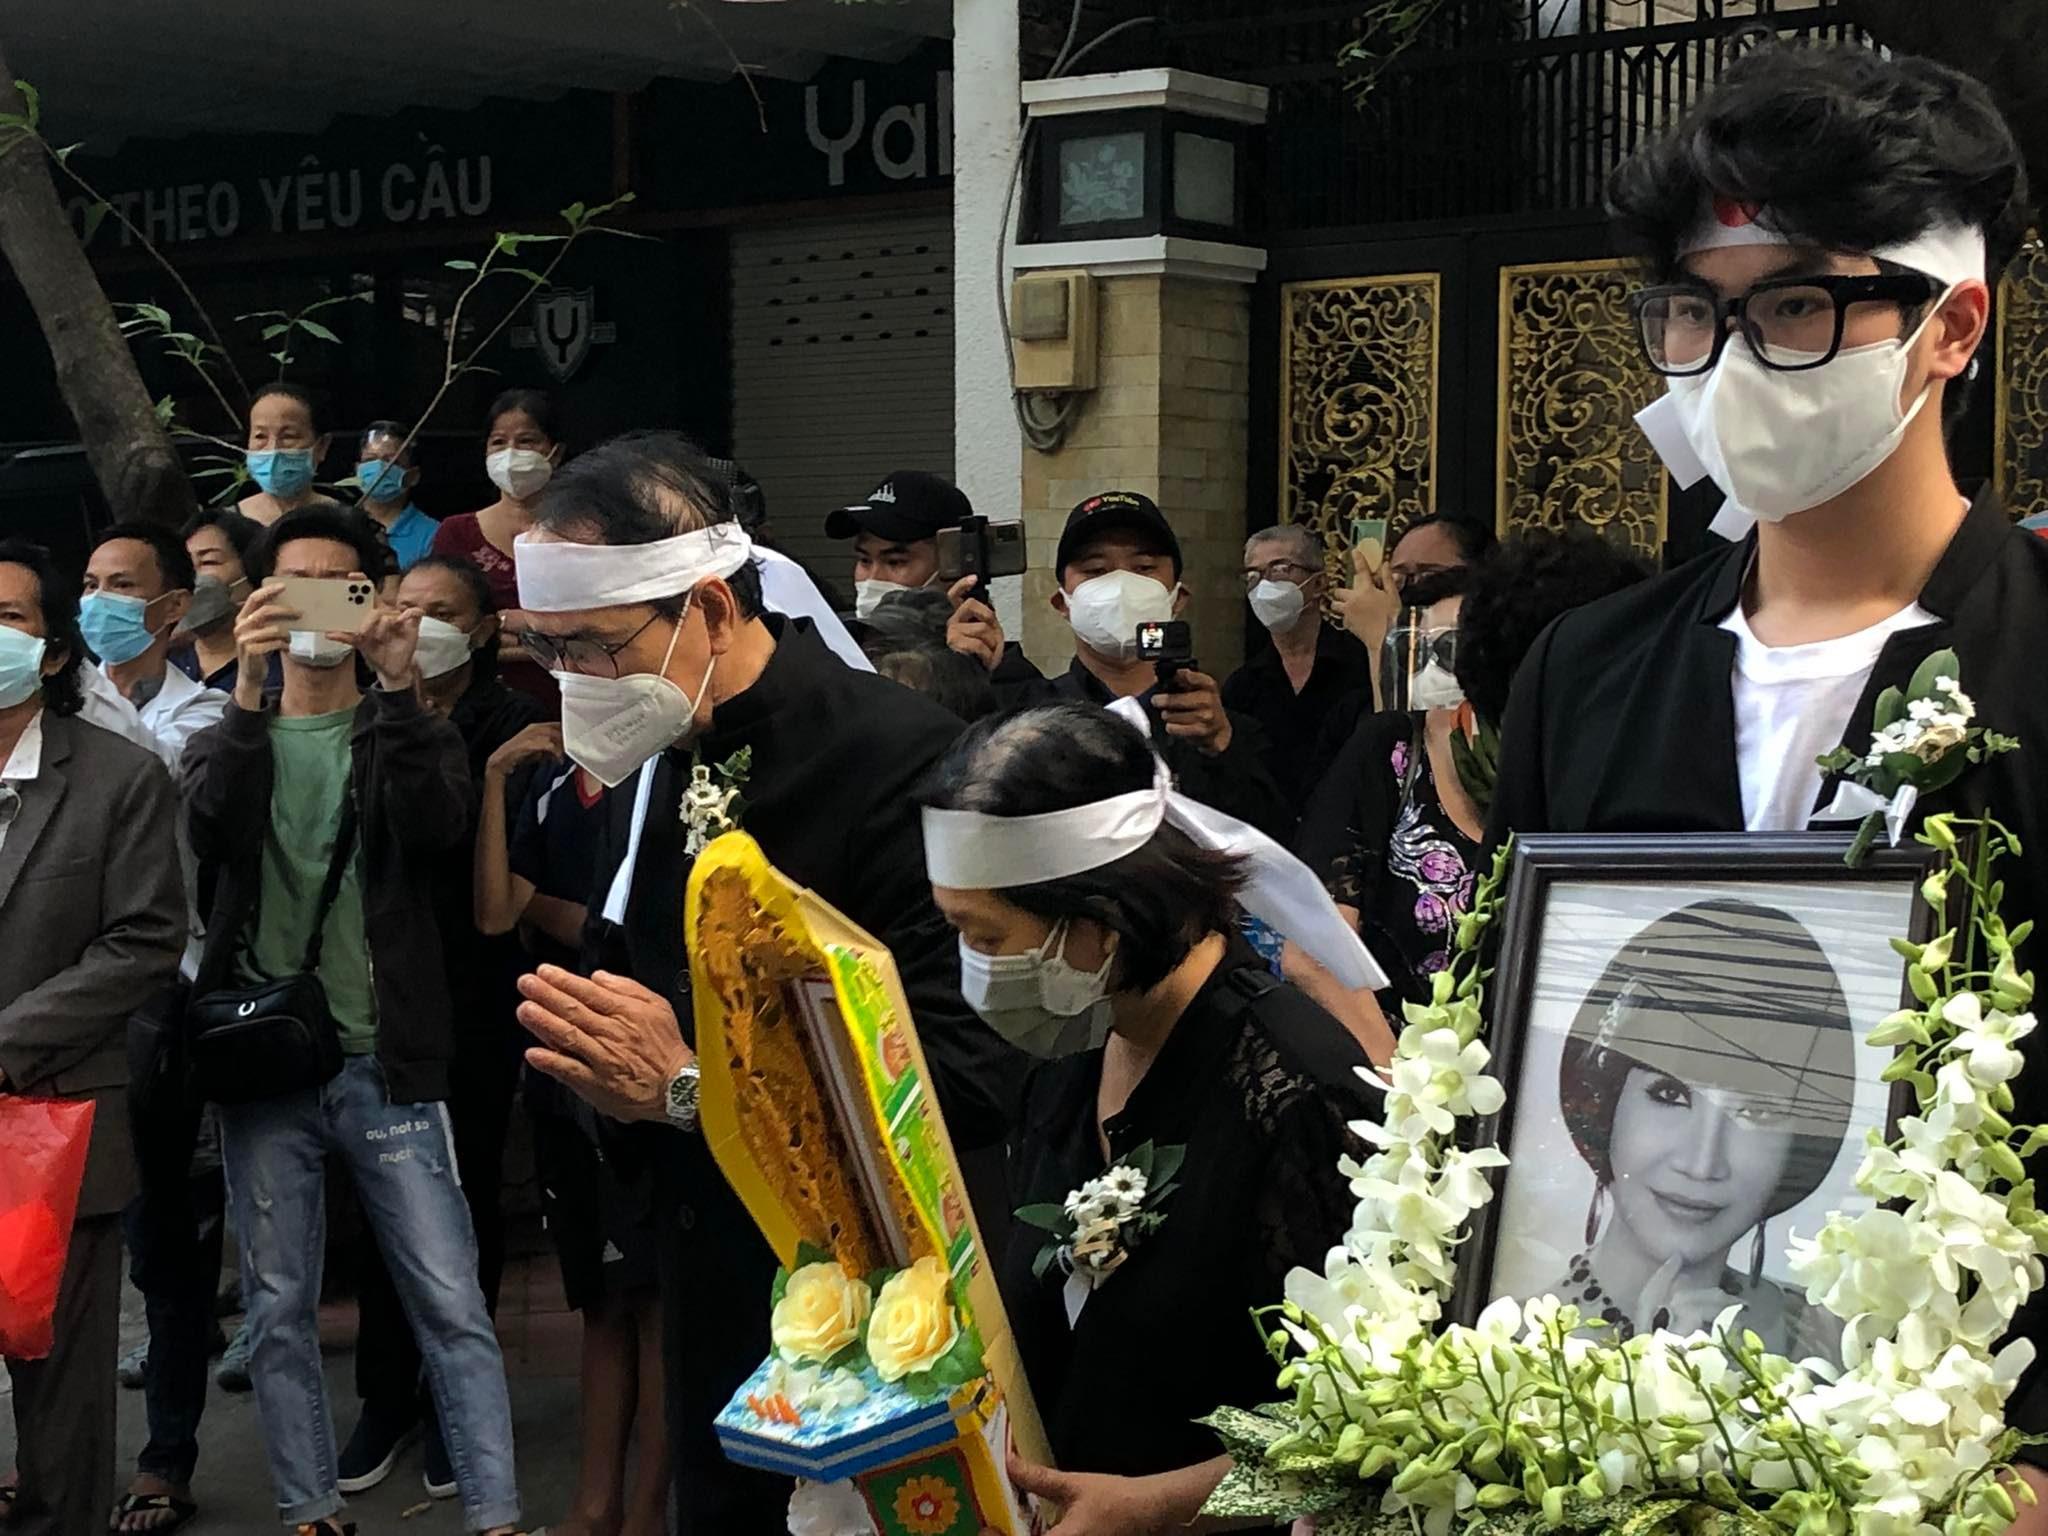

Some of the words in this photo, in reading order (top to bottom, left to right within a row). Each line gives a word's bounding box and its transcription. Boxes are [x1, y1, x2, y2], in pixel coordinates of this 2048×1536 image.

[110, 180, 241, 247] THEO
[258, 153, 363, 233] YÊU
[380, 130, 493, 224] CẦU
[389, 1120, 412, 1137] not
[414, 1120, 430, 1132] so
